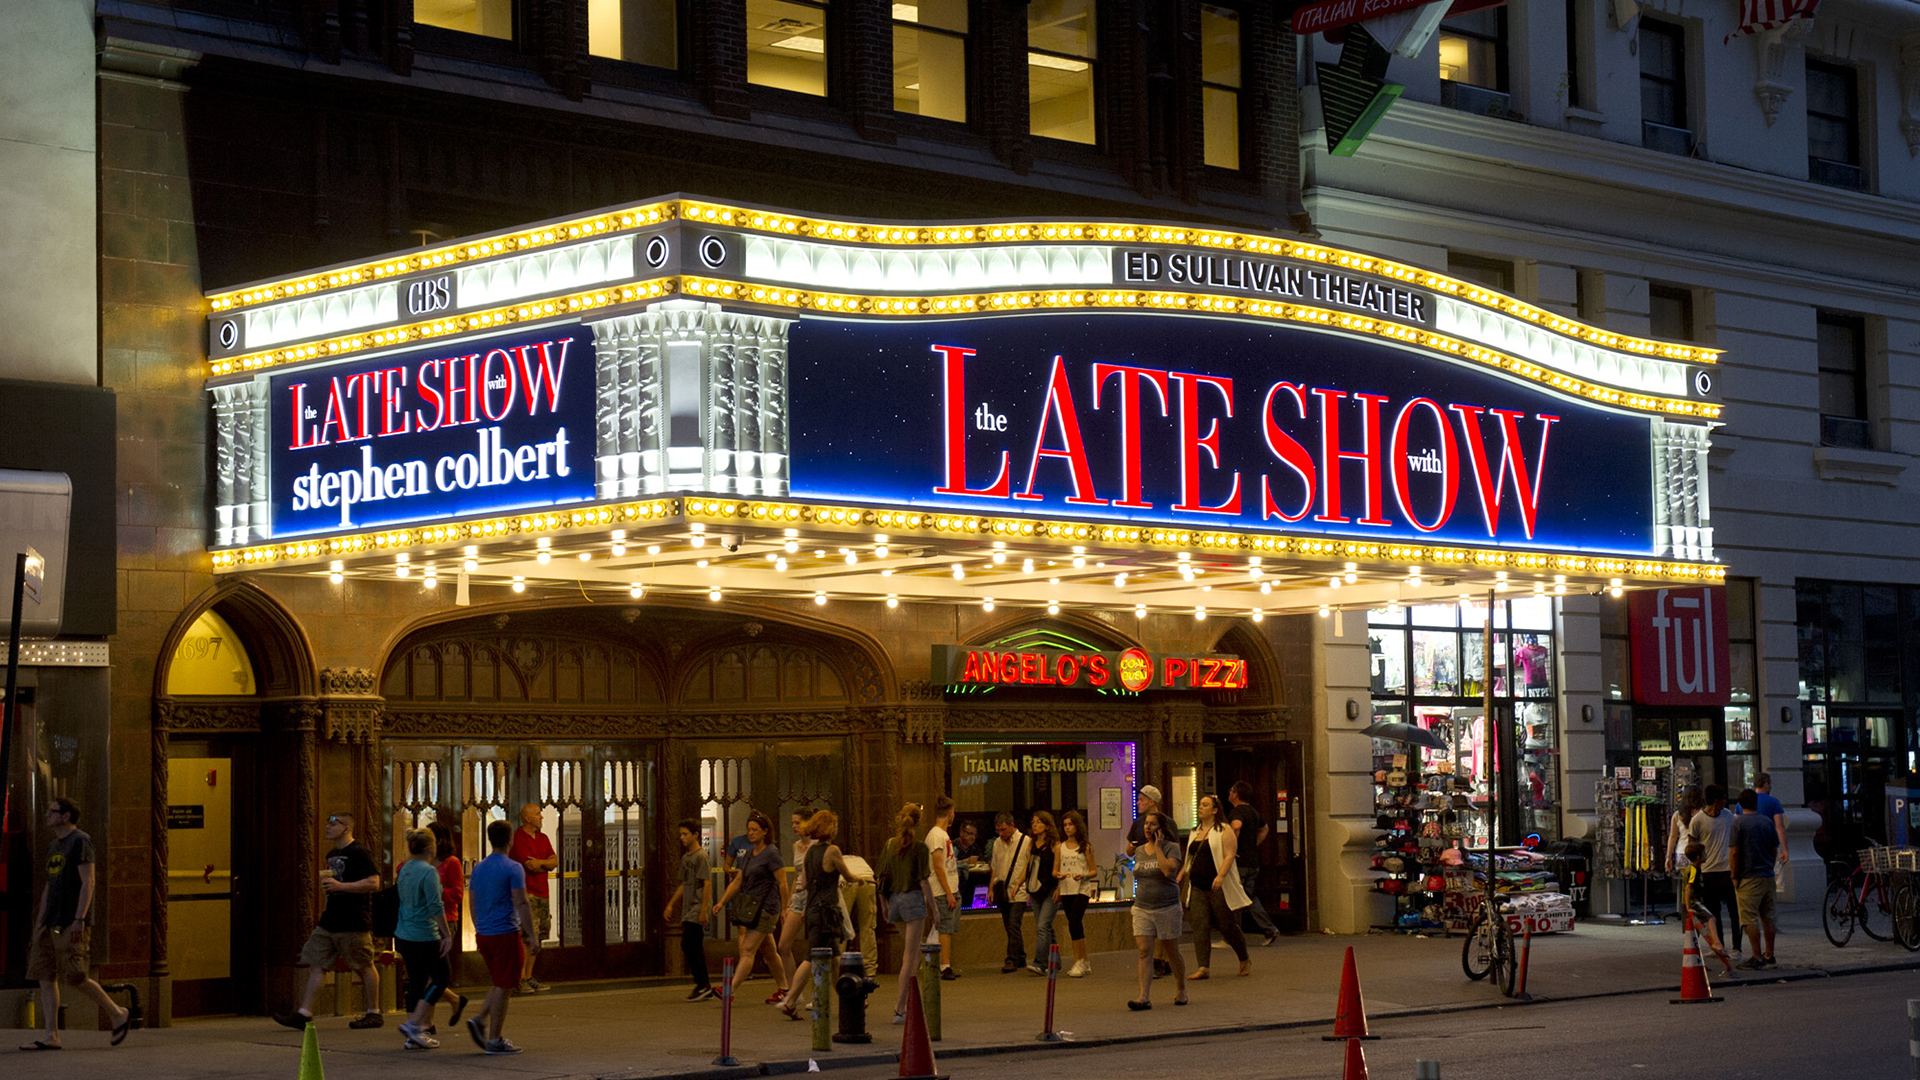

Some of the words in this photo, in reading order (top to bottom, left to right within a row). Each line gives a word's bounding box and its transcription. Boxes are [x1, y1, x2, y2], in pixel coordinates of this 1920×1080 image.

[1298, 0, 1356, 30] ITALIAN
[408, 276, 450, 315] CBS
[1124, 251, 1163, 282] ED
[1168, 253, 1304, 297] SULLIVAN
[1307, 270, 1426, 323] THEATER
[416, 337, 574, 433] SHOW
[487, 377, 507, 391] with
[288, 366, 411, 450] LATE
[304, 406, 317, 420] the
[974, 402, 1008, 432] the
[931, 343, 1242, 516] LATE
[1262, 380, 1560, 540] SHOW
[1407, 449, 1443, 475] with
[292, 445, 430, 527] stephen
[435, 427, 571, 493] colbert
[963, 651, 1110, 686] ANGELO'S
[964, 756, 1018, 773] ITALIAN
[1023, 755, 1113, 772] RESTAURANT
[1895, 798, 1905, 814] P
[1570, 871, 1576, 886] I
[1569, 886, 1587, 902] NY
[1544, 911, 1573, 919] SHIRTS
